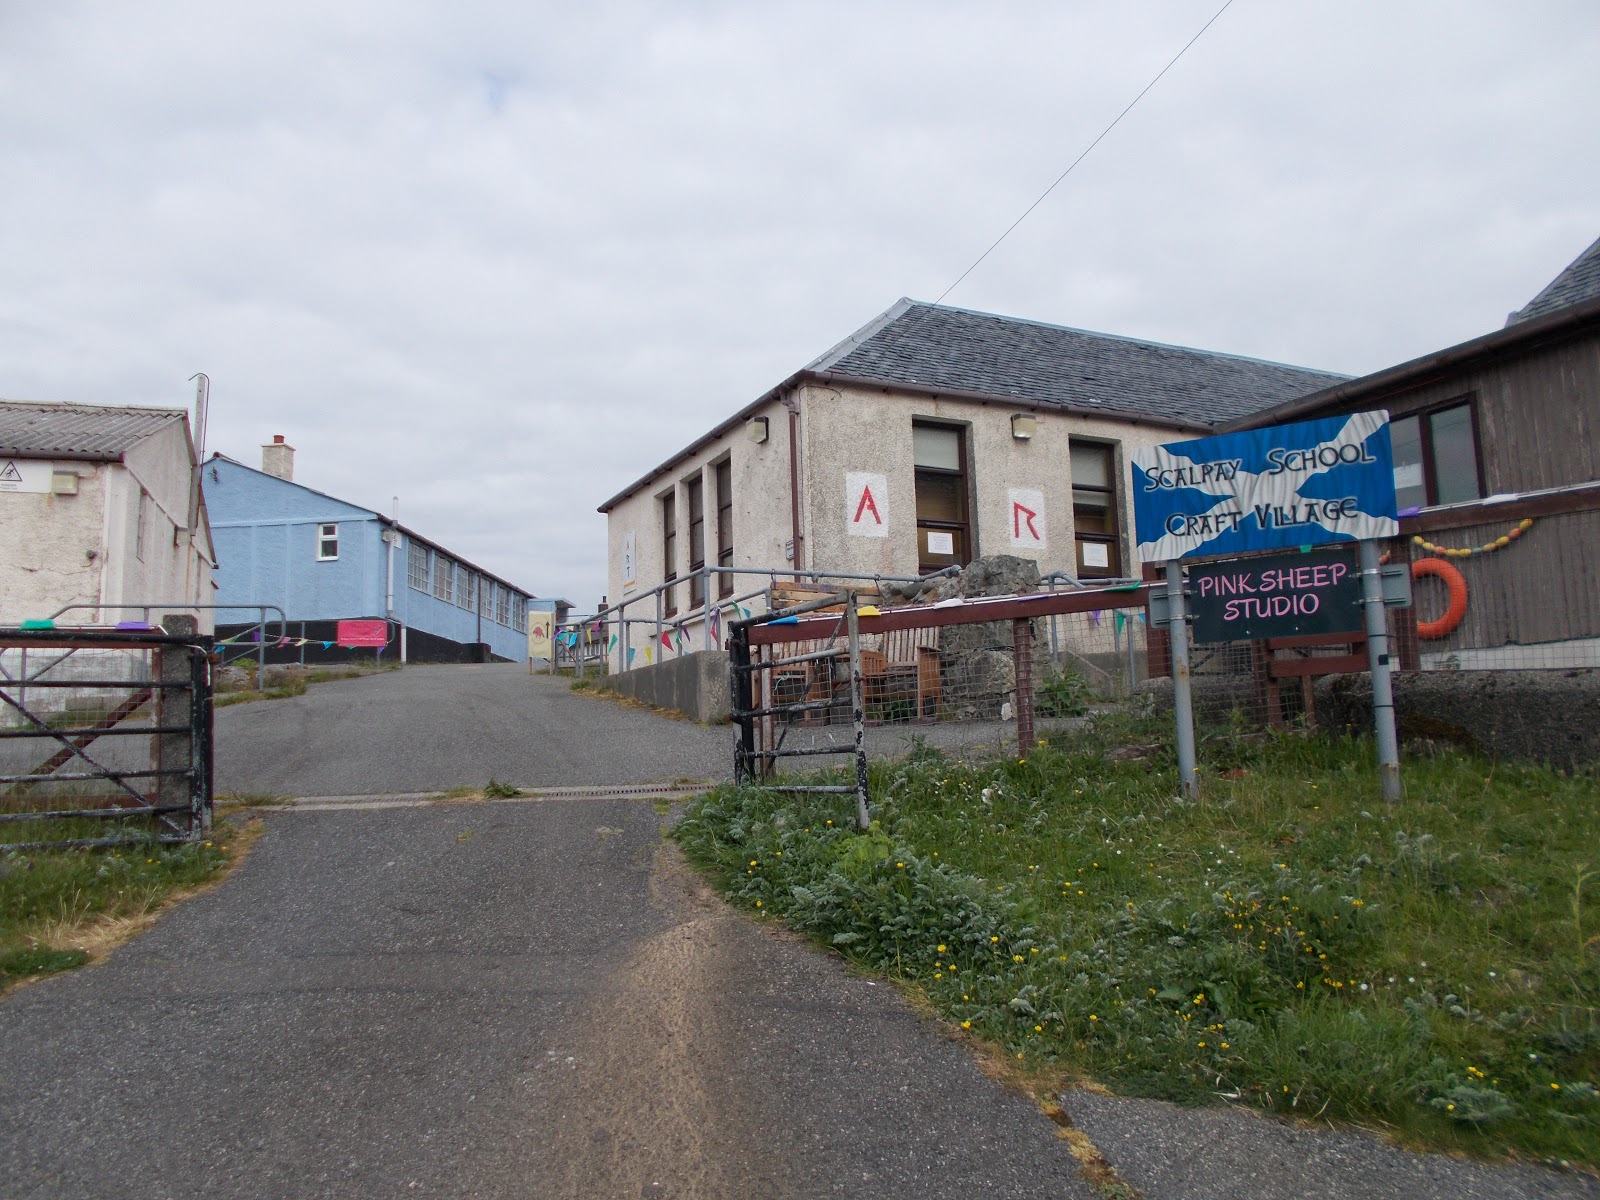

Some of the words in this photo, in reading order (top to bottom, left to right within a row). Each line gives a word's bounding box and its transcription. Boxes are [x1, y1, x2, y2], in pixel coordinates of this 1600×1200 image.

[1144, 459, 1242, 491] SCALPAY
[1267, 442, 1375, 476] SCHOOL
[853, 485, 882, 525] A
[1014, 501, 1041, 541] R
[1165, 512, 1242, 537] CRAFT
[1254, 498, 1359, 529] VILLAGE
[1197, 573, 1257, 598] PINK
[1259, 562, 1348, 592] SHEEP
[1223, 593, 1320, 621] STUDIO
